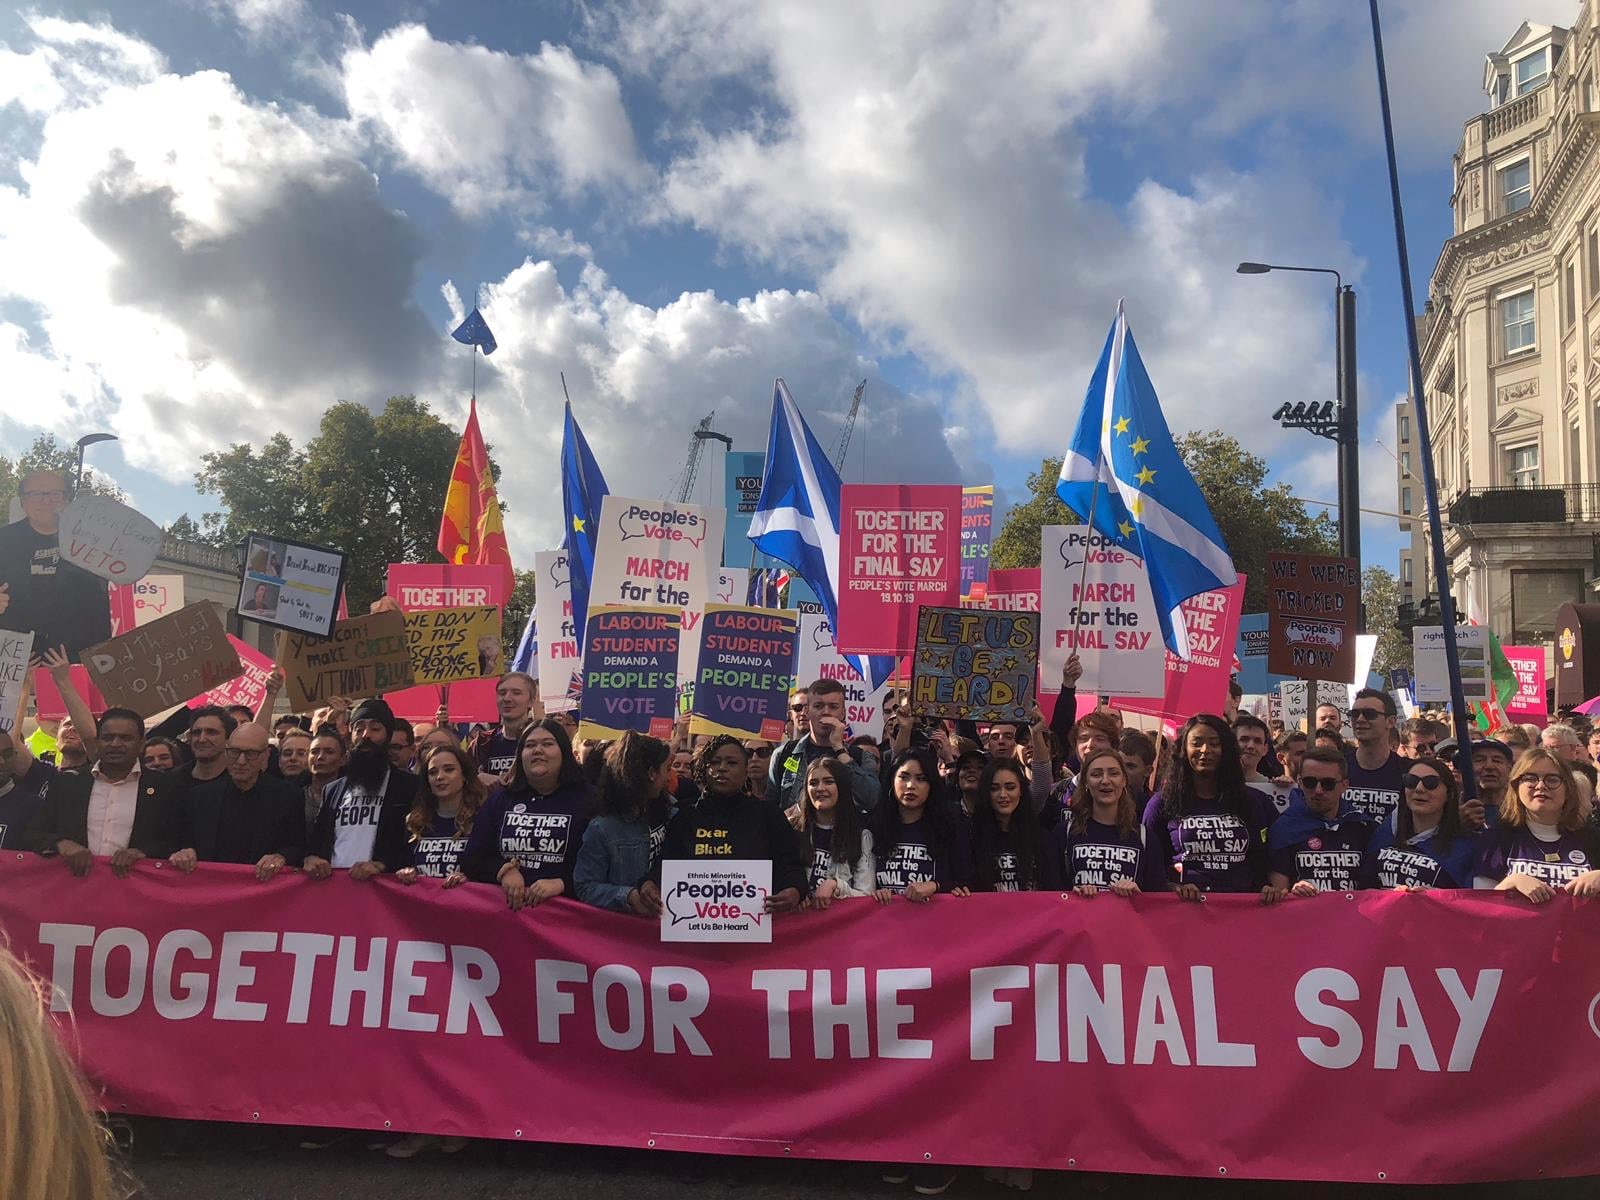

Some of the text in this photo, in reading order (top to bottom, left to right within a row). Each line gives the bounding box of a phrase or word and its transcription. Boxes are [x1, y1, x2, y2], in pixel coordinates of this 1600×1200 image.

[739, 478, 763, 489] YOU
[628, 506, 699, 527] People's
[855, 510, 945, 531] TOGETHER
[643, 524, 683, 541] Vote
[862, 533, 937, 554] FOR THE
[70, 539, 128, 575] VETO
[1087, 549, 1125, 563] Vote
[626, 557, 690, 581] MARCH
[854, 556, 944, 577] FINAL SAY
[1272, 560, 1357, 587] WE WERE
[620, 581, 690, 606] for the
[849, 580, 947, 592] PEOPLE'S VOTE MARCH
[402, 587, 487, 607] TOGETHER
[880, 592, 915, 604] 19.10.19
[1274, 588, 1345, 613] TRICKED
[402, 607, 498, 628] WE DON'T
[599, 615, 668, 631] LABOUR
[679, 611, 702, 631] AY
[714, 613, 783, 634] LABOUR
[1068, 607, 1138, 626] for the
[1184, 609, 1216, 632] THE
[431, 628, 468, 642] THIS
[925, 613, 1033, 648] LET US
[1243, 631, 1269, 641] YOUN
[1290, 621, 1336, 635] People's
[591, 637, 677, 653] STUDENTS
[706, 634, 792, 656] STUDENTS
[1055, 630, 1152, 650] FINAL SAY
[1187, 632, 1220, 653] SAY
[1301, 633, 1327, 644] Vote
[0, 640, 24, 659] KE
[91, 642, 135, 674] Did
[407, 642, 460, 660] SCIST
[1293, 647, 1334, 669] NOW
[603, 656, 659, 666] DEMAND A
[718, 653, 773, 667] DEMAND A
[952, 645, 992, 677] BE
[423, 662, 477, 680] THING
[587, 671, 676, 689] PEOPLE'S
[700, 667, 790, 692] PEOPLE'S
[1519, 672, 1535, 683] THE
[296, 664, 371, 703] WITHOUT
[1522, 685, 1537, 696] SAY
[232, 690, 258, 708] SAY
[716, 694, 769, 715] VOTE
[916, 674, 1029, 717] HEARD!
[604, 697, 656, 714] VOTE
[847, 705, 876, 722] SAY
[335, 806, 378, 827] PEOPL
[1368, 802, 1386, 814] the
[506, 813, 569, 828] TOGETHER
[1181, 816, 1243, 829] TOGETHER
[515, 827, 551, 838] for the
[696, 828, 729, 838] Dear
[1196, 829, 1234, 839] for the
[501, 838, 565, 853] FINAL SAY
[1184, 838, 1248, 853] FINAL SAY
[425, 853, 457, 863] for the
[1075, 846, 1137, 864] TOGETHER
[1298, 853, 1361, 868] TOGETHER
[1377, 848, 1438, 871] TOGETHER
[885, 860, 919, 871] for the
[1086, 859, 1122, 872] for the
[1313, 868, 1349, 878] for the
[1383, 861, 1419, 877] for the
[876, 870, 905, 885] FINAL
[1074, 870, 1107, 885] FINAL
[676, 881, 757, 904] People's
[695, 902, 741, 919] Vote
[689, 923, 749, 931] Let Us Be Heard
[39, 922, 1503, 1072] TOGETHER FOR THE FINAL SAY
